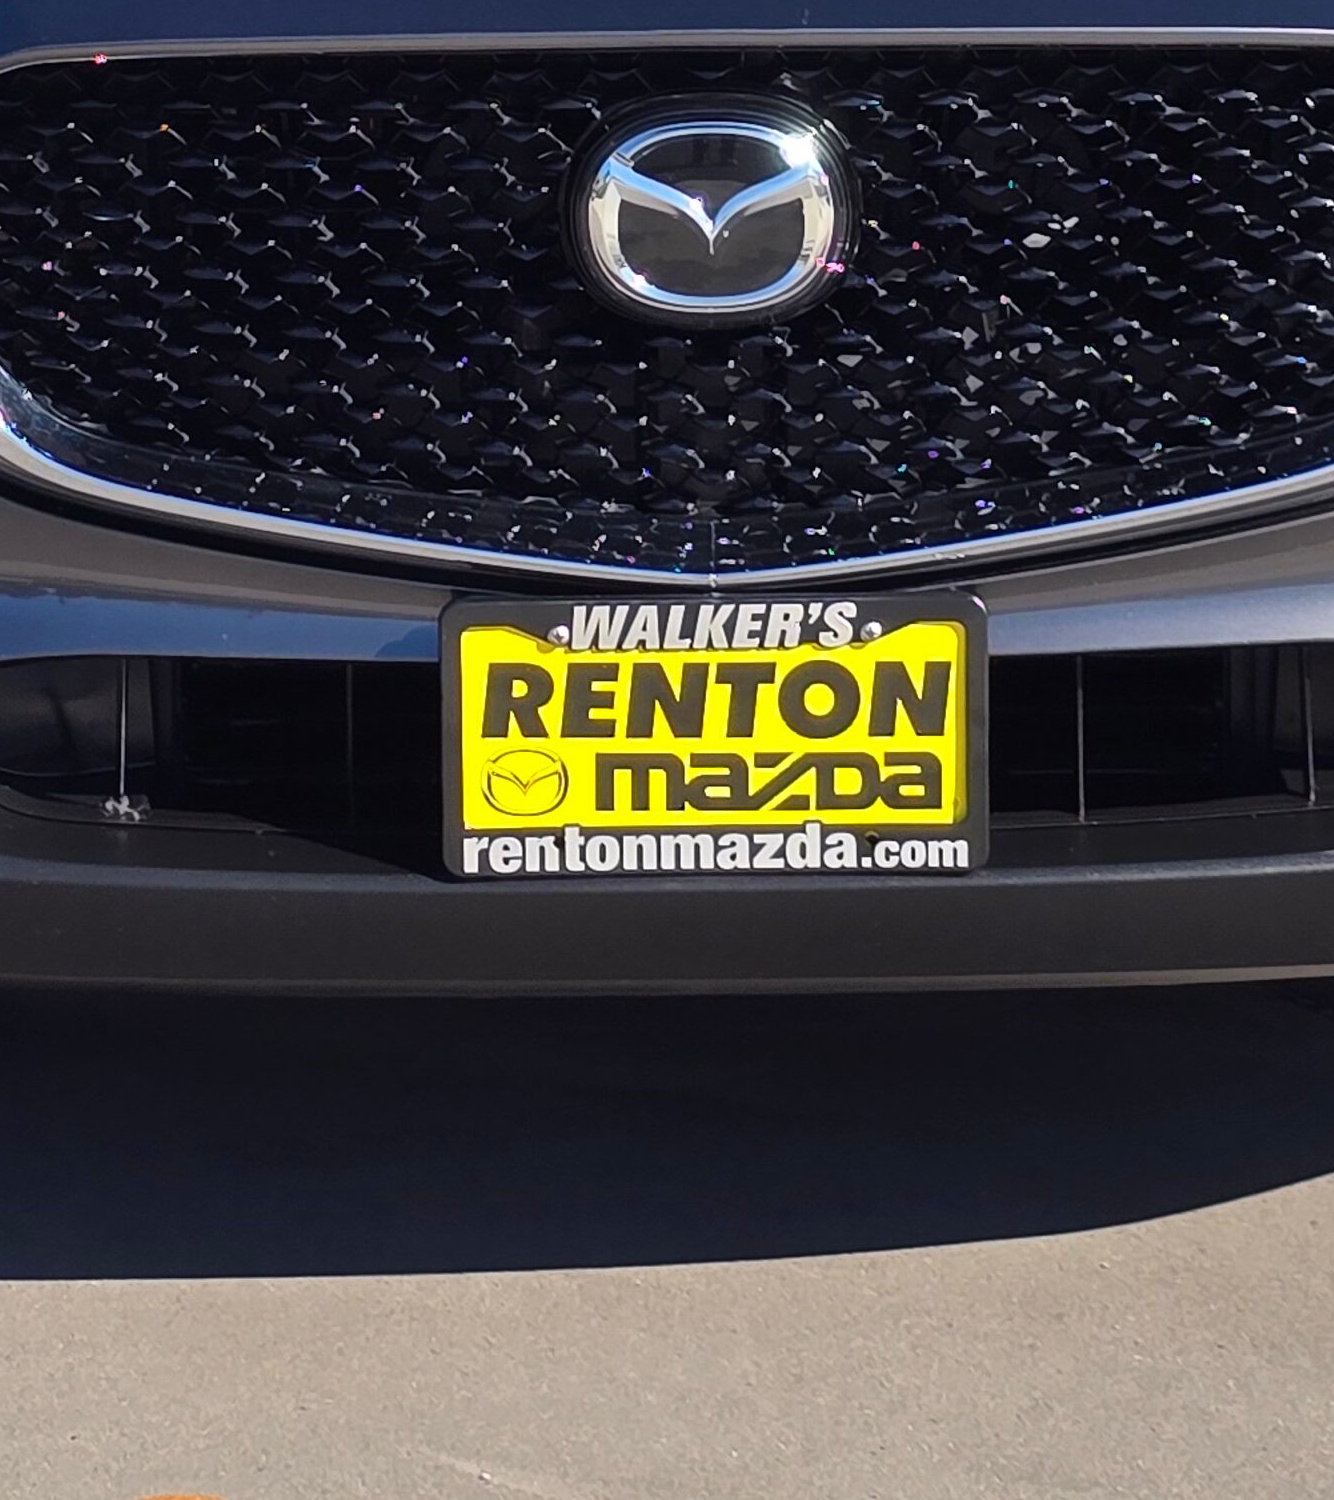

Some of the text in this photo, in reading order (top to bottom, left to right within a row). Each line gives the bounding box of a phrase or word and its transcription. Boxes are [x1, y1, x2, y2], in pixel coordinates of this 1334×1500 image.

[571, 603, 858, 650] WALKER'S
[481, 660, 952, 739] RENTON
[595, 751, 943, 811] mazda
[463, 822, 970, 874] rentonmazda.com
